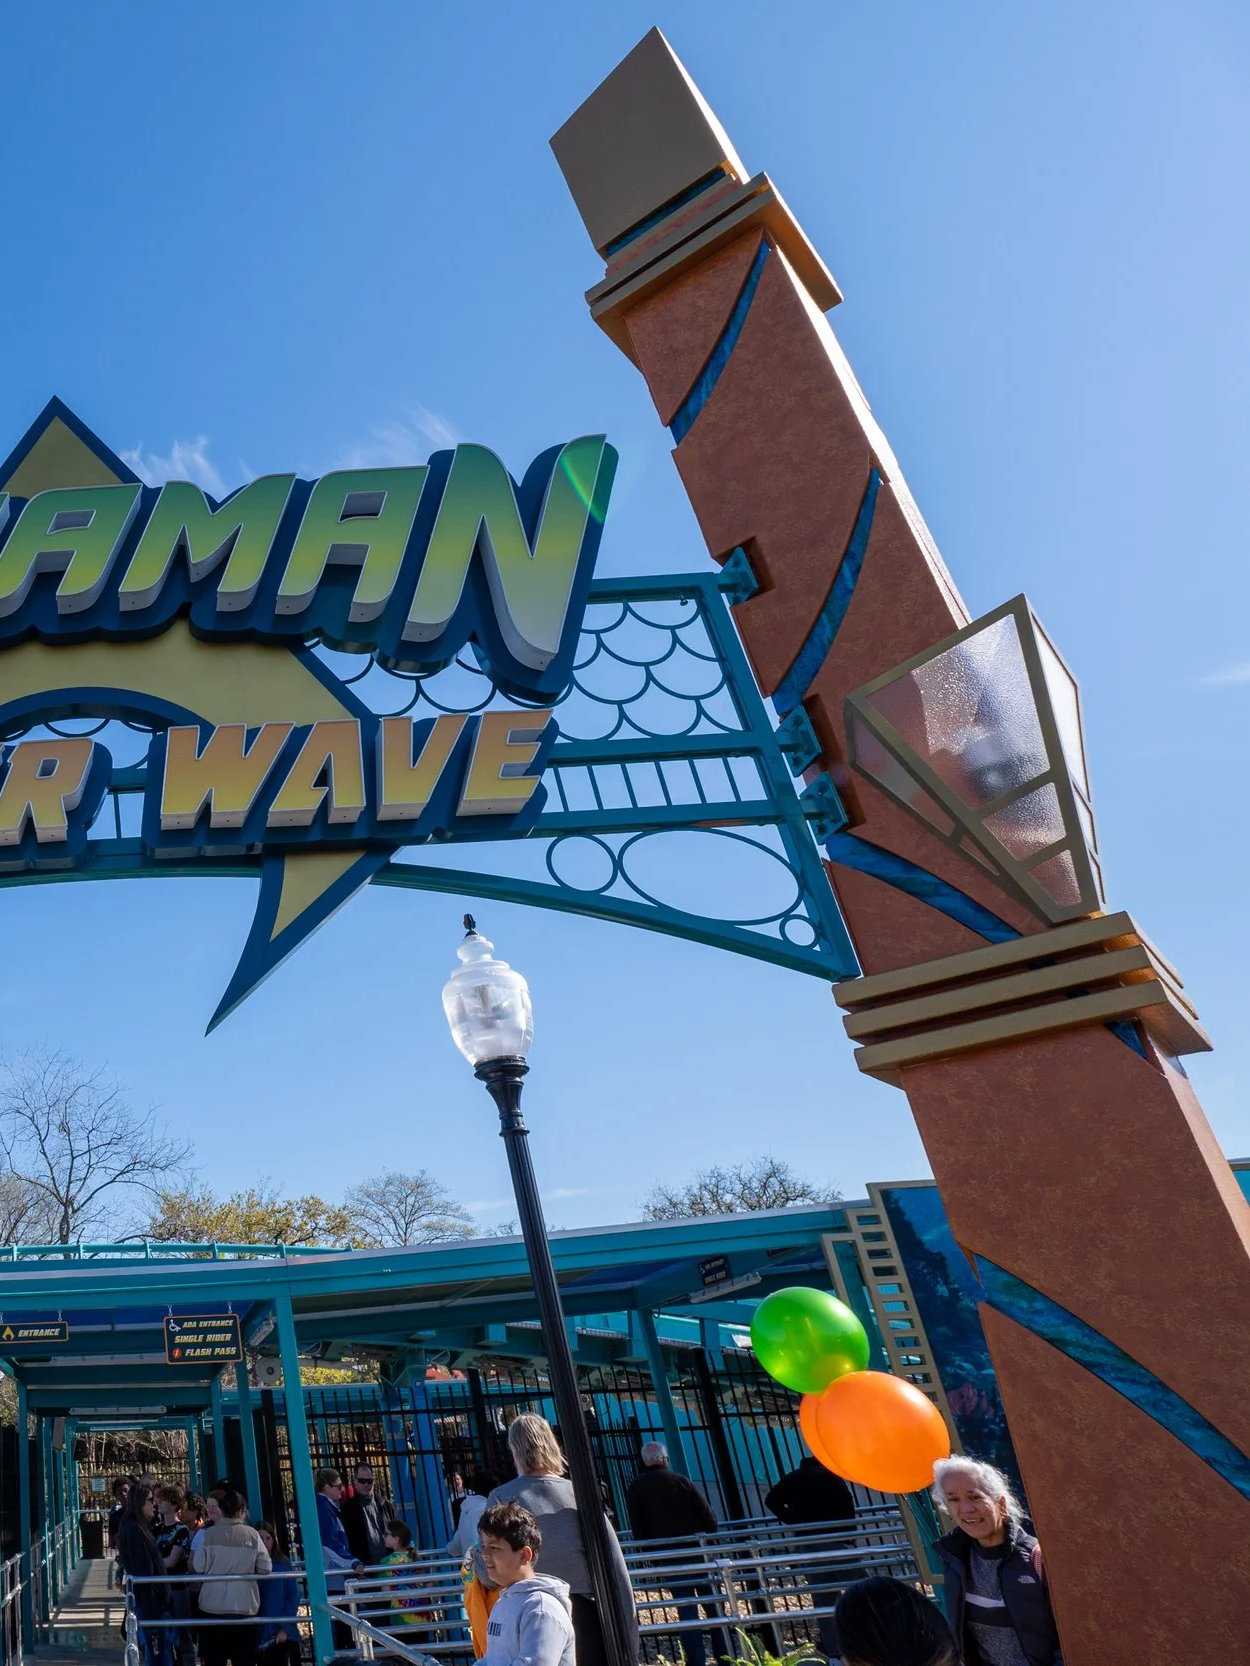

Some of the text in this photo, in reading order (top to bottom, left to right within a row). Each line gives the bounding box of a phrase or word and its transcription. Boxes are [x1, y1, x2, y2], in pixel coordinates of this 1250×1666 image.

[159, 708, 555, 830] WAVE
[182, 1319, 234, 1329] ADA ENTRANCE
[17, 1328, 61, 1338] ENTRANCE
[174, 1333, 232, 1343] SINGLE RIDER
[185, 1346, 237, 1357] FLASH PASS
